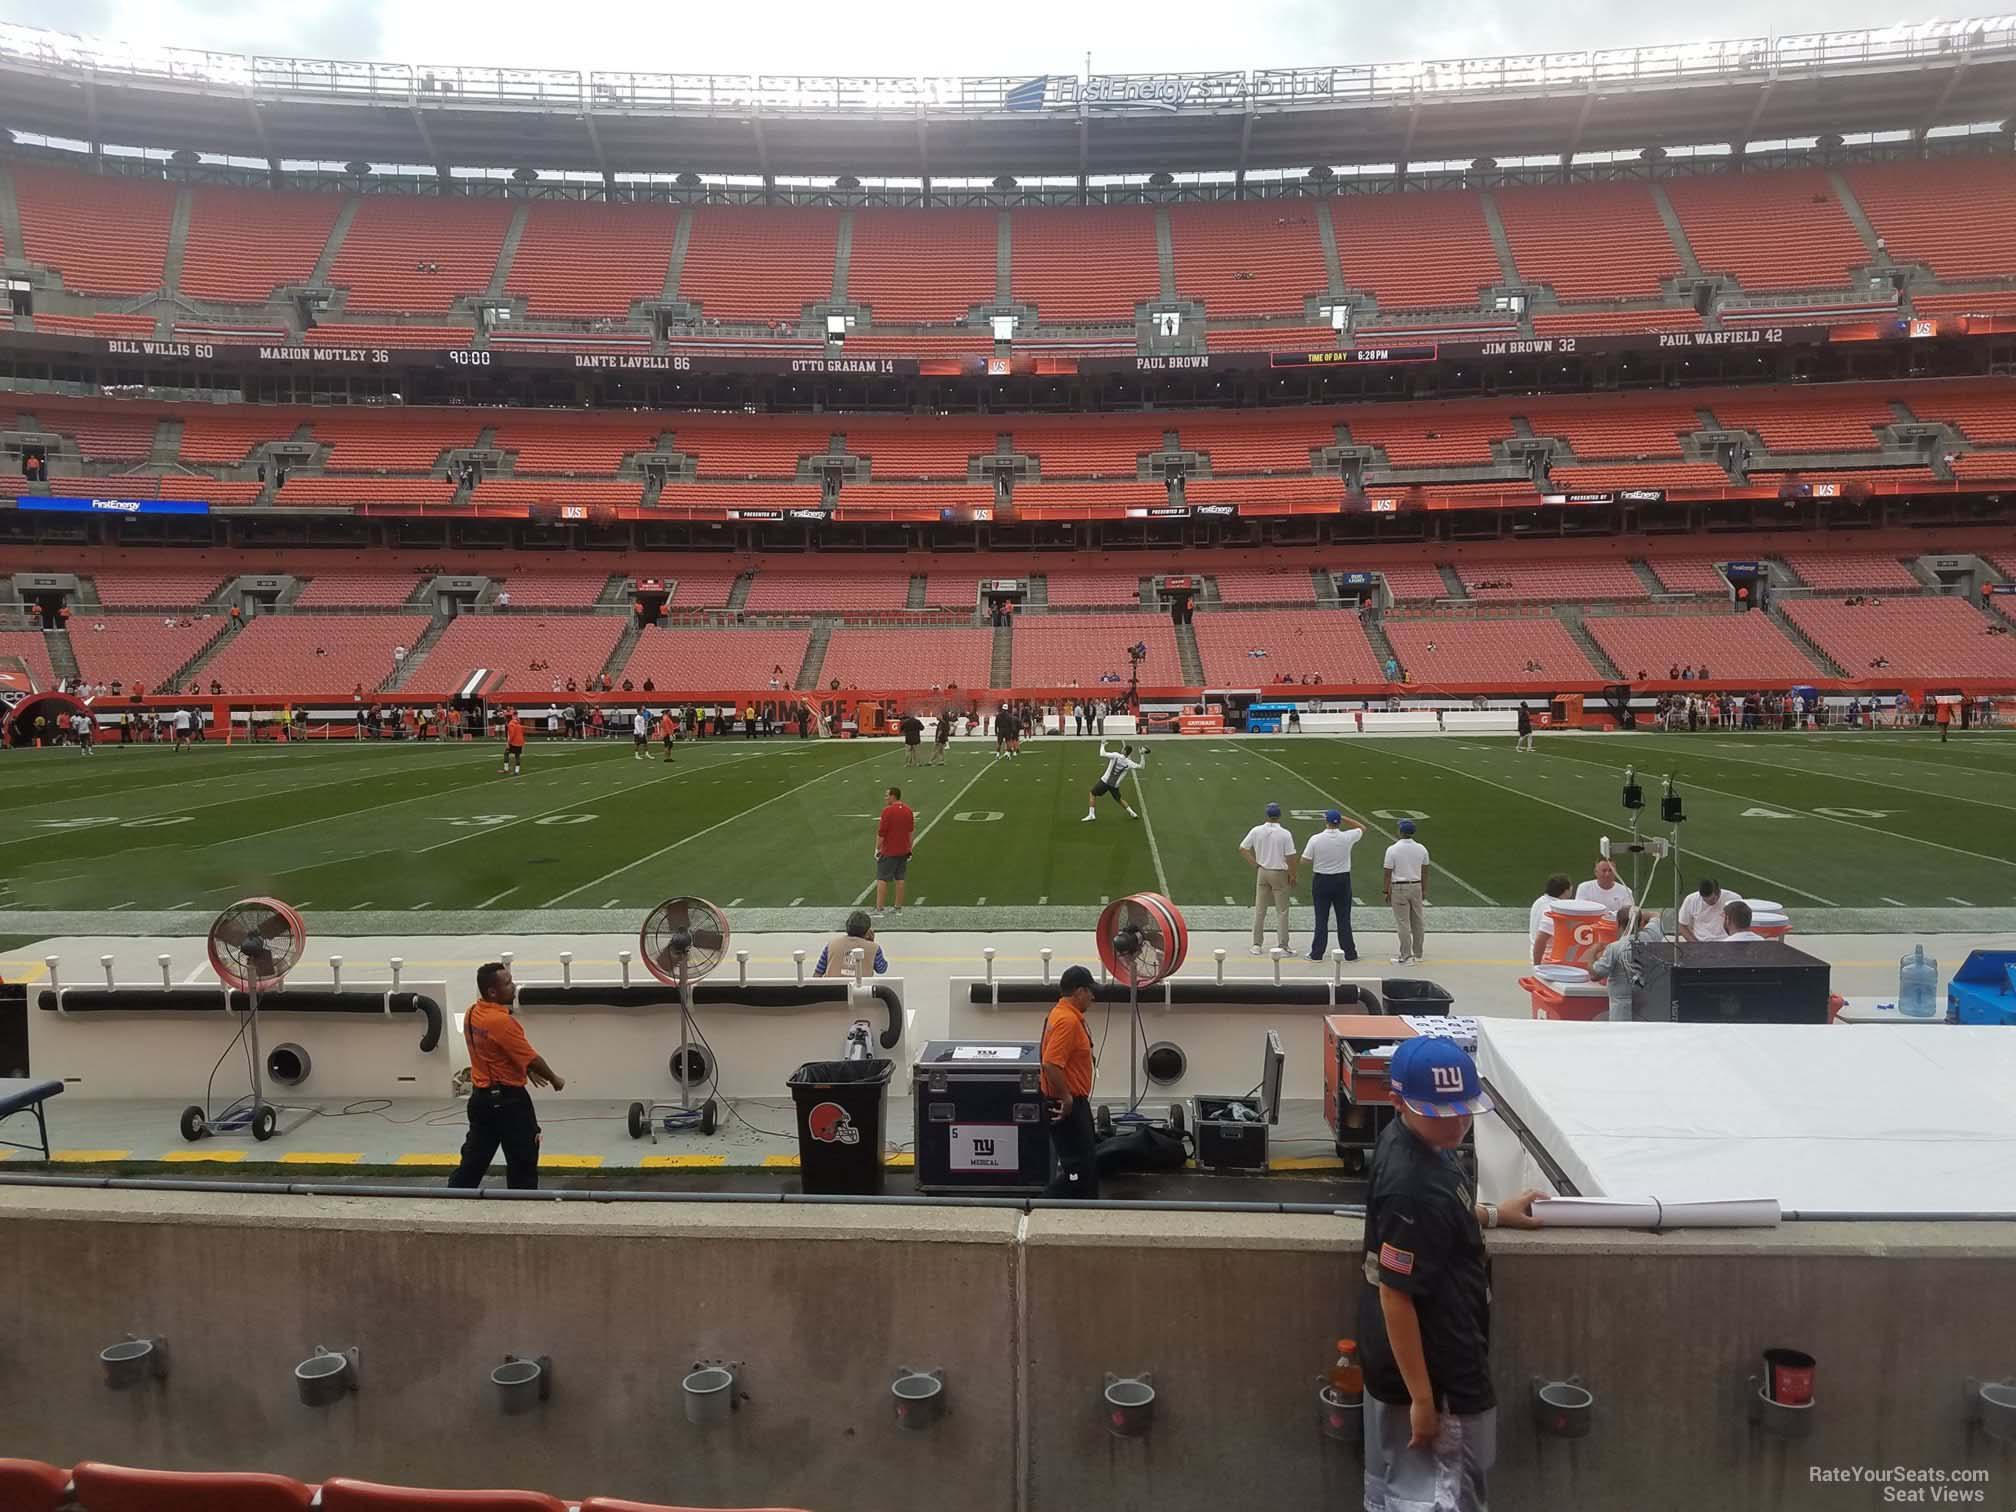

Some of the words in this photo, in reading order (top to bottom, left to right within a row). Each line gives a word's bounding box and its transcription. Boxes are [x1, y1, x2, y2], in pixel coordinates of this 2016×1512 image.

[1055, 78, 1193, 104] FirstEnergy
[1199, 76, 1334, 97] STADIUM
[1917, 322, 1930, 335] VS
[1659, 333, 1692, 346] PAUL
[1694, 331, 1760, 344] WARFIELD
[1764, 328, 1783, 342] 42
[109, 340, 139, 354] BILL
[143, 342, 190, 357] WILLIS
[195, 344, 213, 359] 60
[1481, 343, 1507, 355] JIM
[1509, 340, 1553, 353] BROWN
[1558, 338, 1576, 351] 32
[259, 347, 310, 361] MARION
[313, 349, 367, 362] MOTLEY
[372, 350, 389, 363] 36
[450, 351, 490, 365] 90:00
[1308, 354, 1324, 362] TIME
[1334, 353, 1348, 361] DAY
[1358, 351, 1375, 360] 6:28
[1376, 350, 1388, 359] PM
[575, 355, 617, 368] DANTE
[620, 355, 669, 369] LAVELLI
[673, 357, 691, 370] 86
[791, 360, 824, 372] OTTO
[827, 360, 877, 373] GRAHAM
[880, 360, 894, 373] 14
[991, 361, 1005, 371] VS
[1136, 357, 1166, 370] PAUL
[1168, 356, 1209, 369] BROWN
[1621, 490, 1660, 500] FirstEnergy
[1820, 484, 1834, 496] VS
[92, 499, 141, 512] FirstEnergy
[1197, 505, 1234, 515] FirstEnergy
[1377, 500, 1391, 511] VS
[567, 507, 582, 518] VS
[790, 509, 826, 520] FirstEnergy
[1573, 924, 1594, 945] G
[952, 1127, 958, 1139] 5
